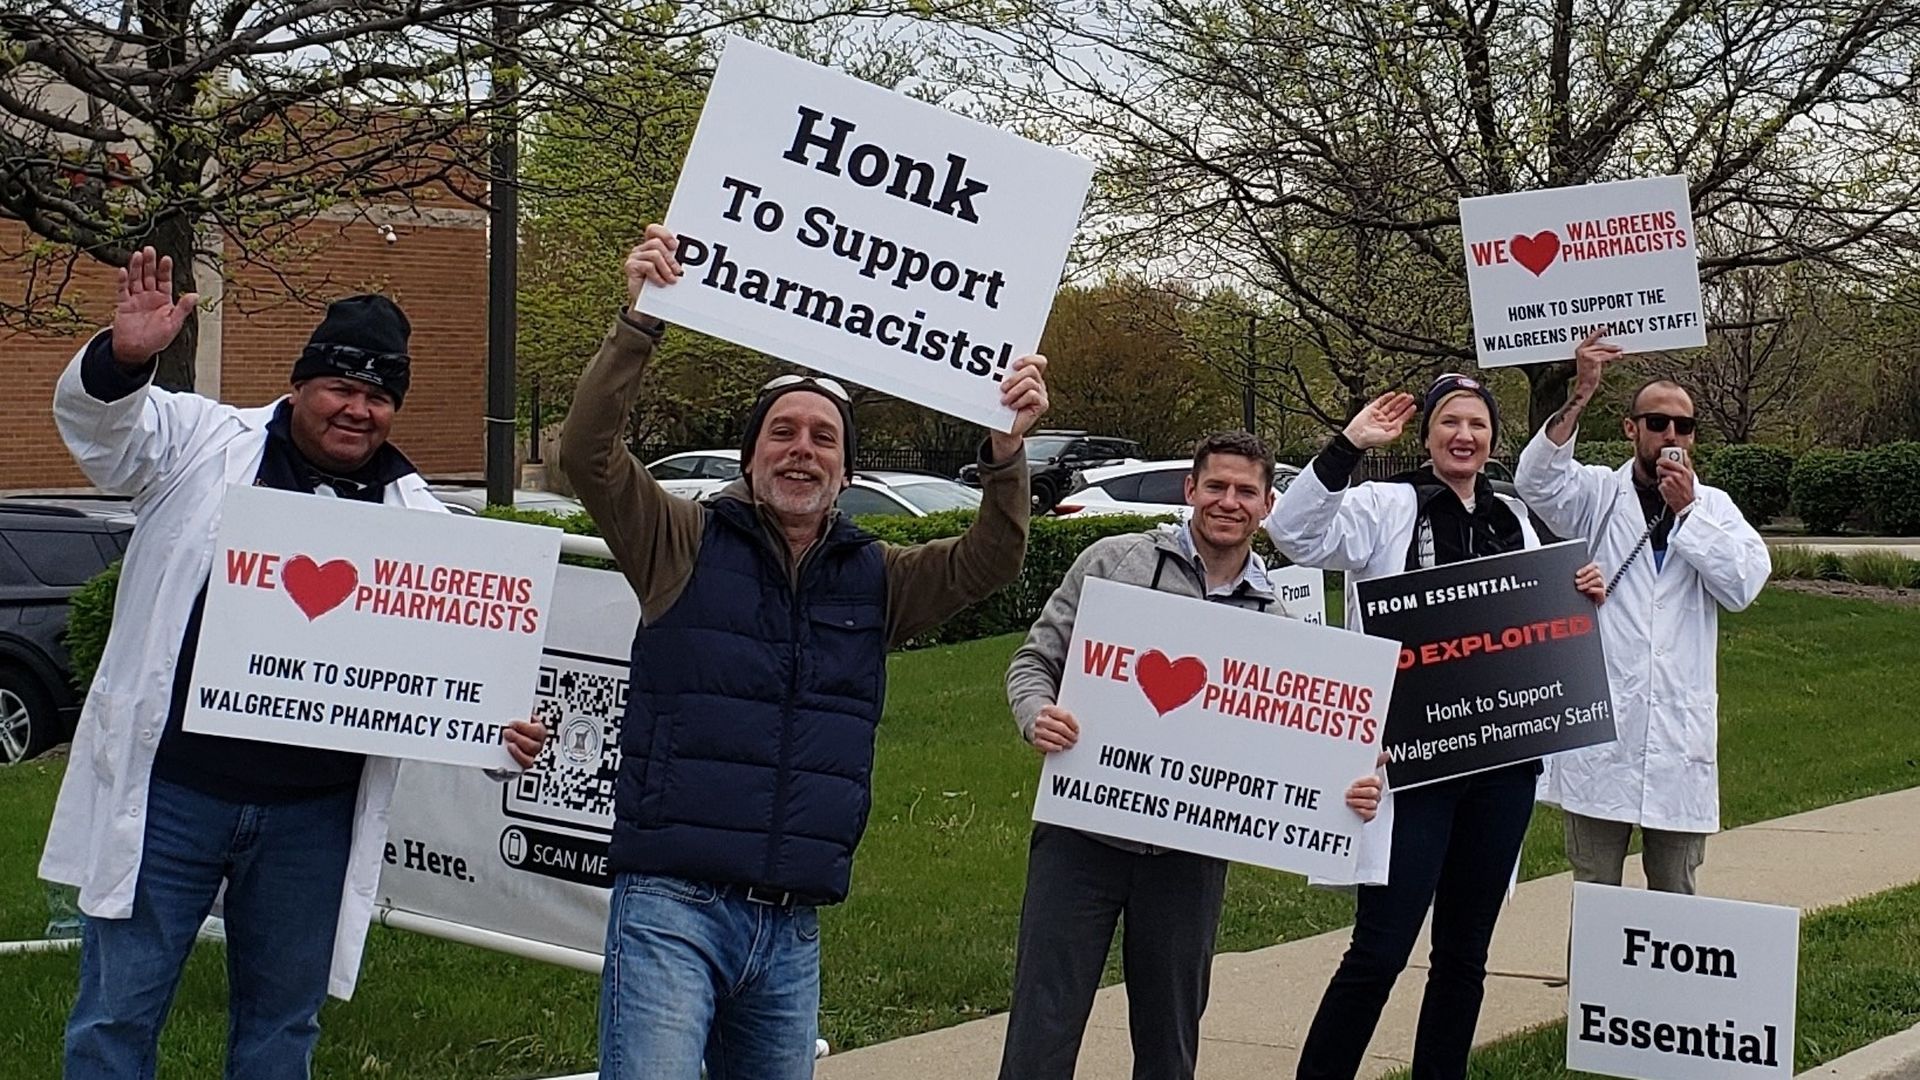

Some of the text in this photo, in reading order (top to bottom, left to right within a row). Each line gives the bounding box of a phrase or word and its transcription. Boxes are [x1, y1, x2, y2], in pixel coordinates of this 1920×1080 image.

[782, 105, 989, 224] Honk
[722, 176, 1005, 309] To Support
[1471, 210, 1677, 267] WE WALGREENS
[1561, 229, 1687, 263] PHARMACISTS
[675, 233, 1013, 382] Pharmacists!
[1508, 289, 1666, 322] HONK TO SUPPORT THE
[1483, 327, 1567, 352] WALGREENS
[1648, 312, 1698, 332] STAFF!
[226, 549, 532, 604] WE WALGREENS
[1281, 584, 1310, 601] From
[1367, 575, 1538, 617] FROM ESSENTIAL...
[355, 585, 538, 634] PHARMACISTS
[1420, 614, 1593, 665] EXPLOITED
[249, 654, 483, 703] HONK TO SUPPORT THE
[1083, 640, 1373, 714] WE WALGREENS
[1426, 680, 1563, 723] Honk to Support
[200, 688, 325, 723] WALGREENS
[330, 705, 442, 738] PHARMACY
[1202, 684, 1377, 744] PHARMACISTS
[1386, 701, 1609, 764] Walgreens Pharmacy Staff!
[1099, 745, 1321, 810] HONK TO SUPPORT THE
[1052, 775, 1352, 857] WALGREENS PHARMACY STAFF!
[403, 839, 475, 883] Here.
[533, 844, 608, 876] SCAN ME
[1622, 927, 1737, 979] From
[1579, 1003, 1778, 1067] Essential
